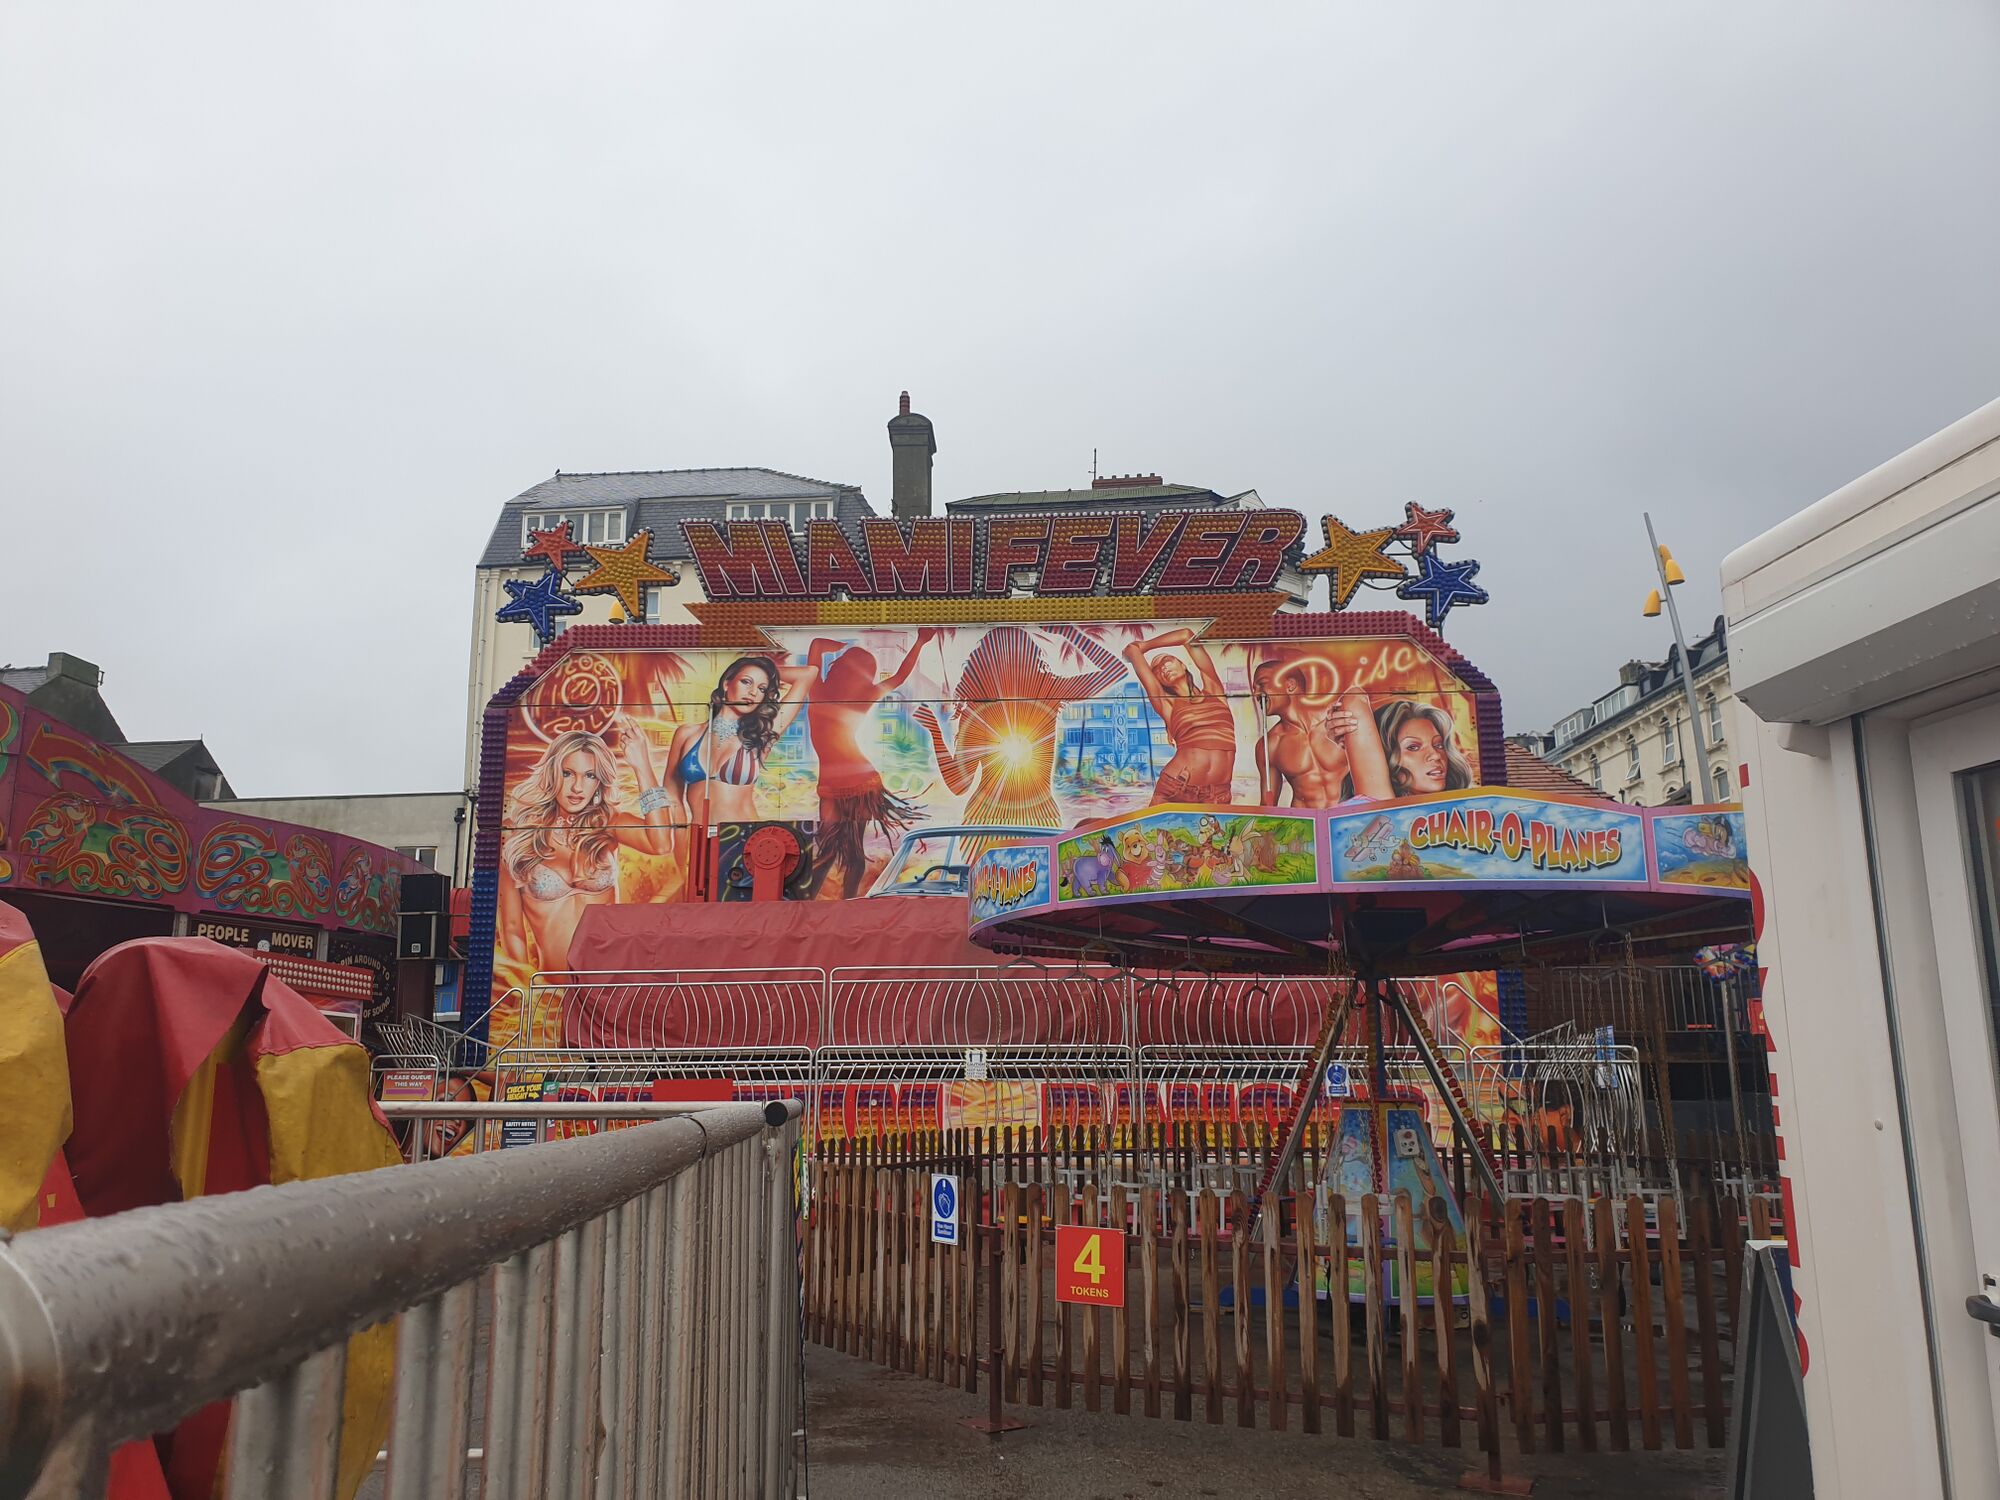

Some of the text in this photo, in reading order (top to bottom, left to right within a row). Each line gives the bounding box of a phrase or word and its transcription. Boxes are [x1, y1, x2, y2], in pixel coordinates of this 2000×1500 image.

[679, 509, 1305, 598] MIAMI FEVER
[1409, 807, 1621, 873] CHAIR-O-PLANES
[197, 923, 314, 949] PEOPLE MOVER
[354, 954, 381, 970] AROUND
[382, 966, 390, 980] TO
[363, 996, 391, 1018] OF SOUND
[507, 1085, 526, 1094] CHECK
[526, 1083, 542, 1092] YOUR
[507, 1091, 528, 1101] HEIGHT
[1074, 1234, 1105, 1284] 4
[1070, 1286, 1109, 1298] TOKENS
